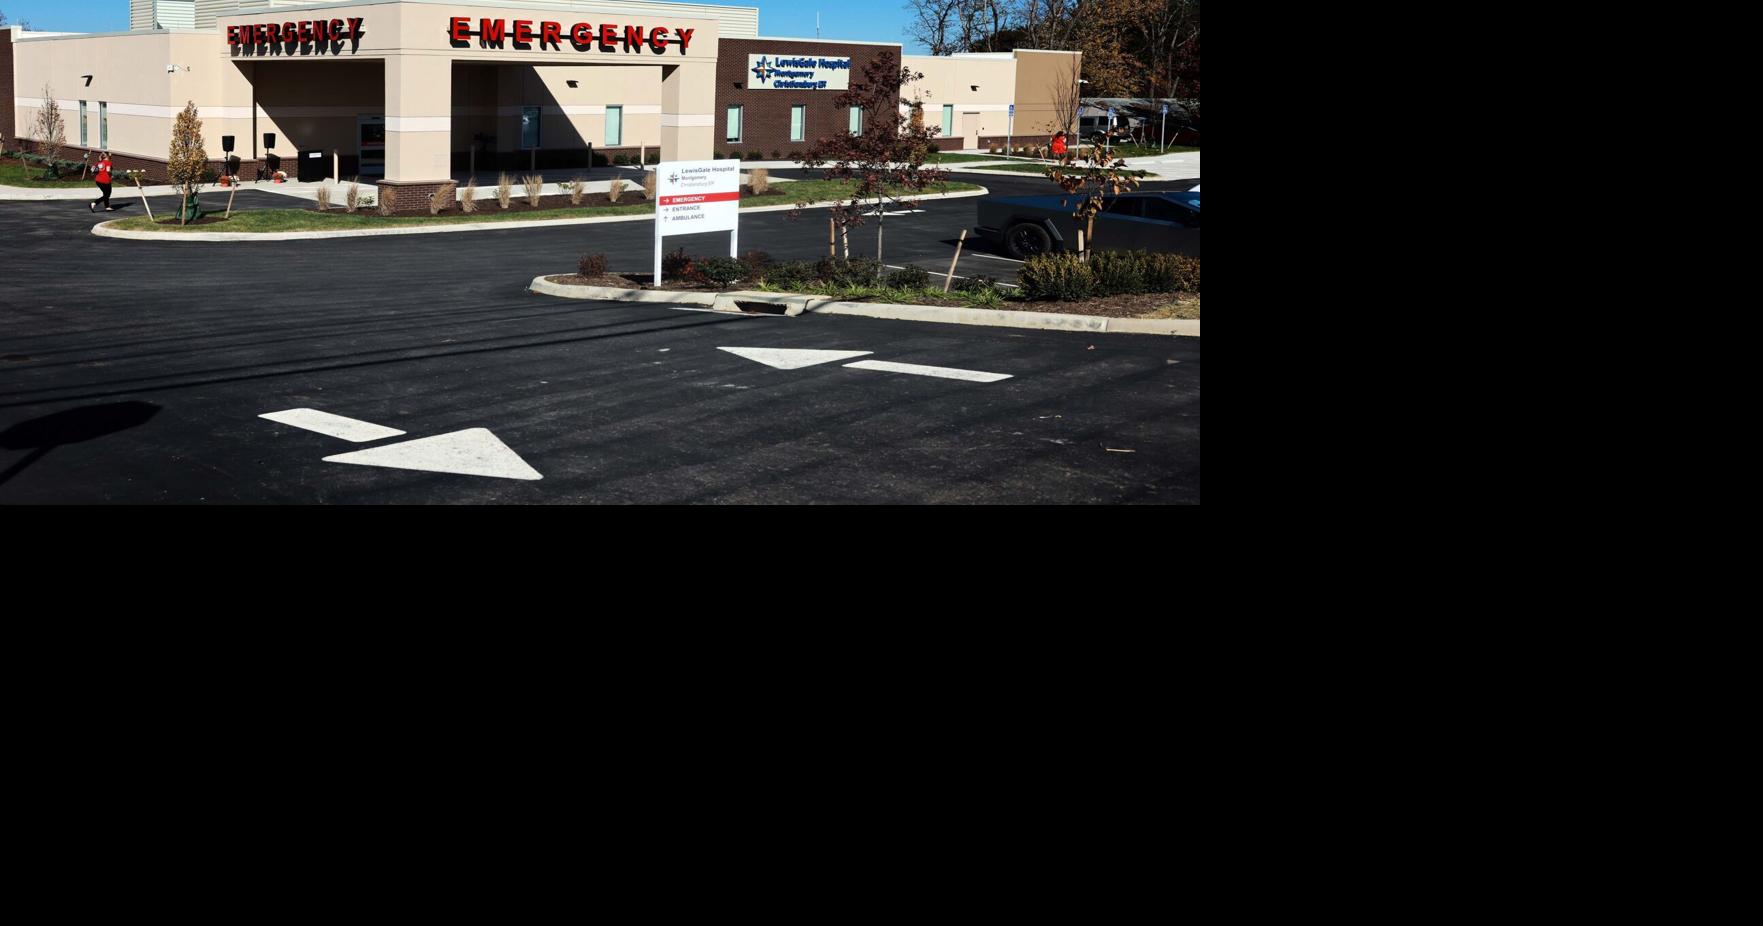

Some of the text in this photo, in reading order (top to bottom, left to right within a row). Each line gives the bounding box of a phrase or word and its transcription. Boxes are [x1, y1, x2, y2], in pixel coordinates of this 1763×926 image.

[227, 17, 364, 45] EMERGENCY
[450, 16, 695, 48] EMERGENCY
[775, 57, 851, 70] LewisGale Hospital
[774, 70, 814, 79] Montgomery
[672, 213, 705, 221] AMBULANCE
